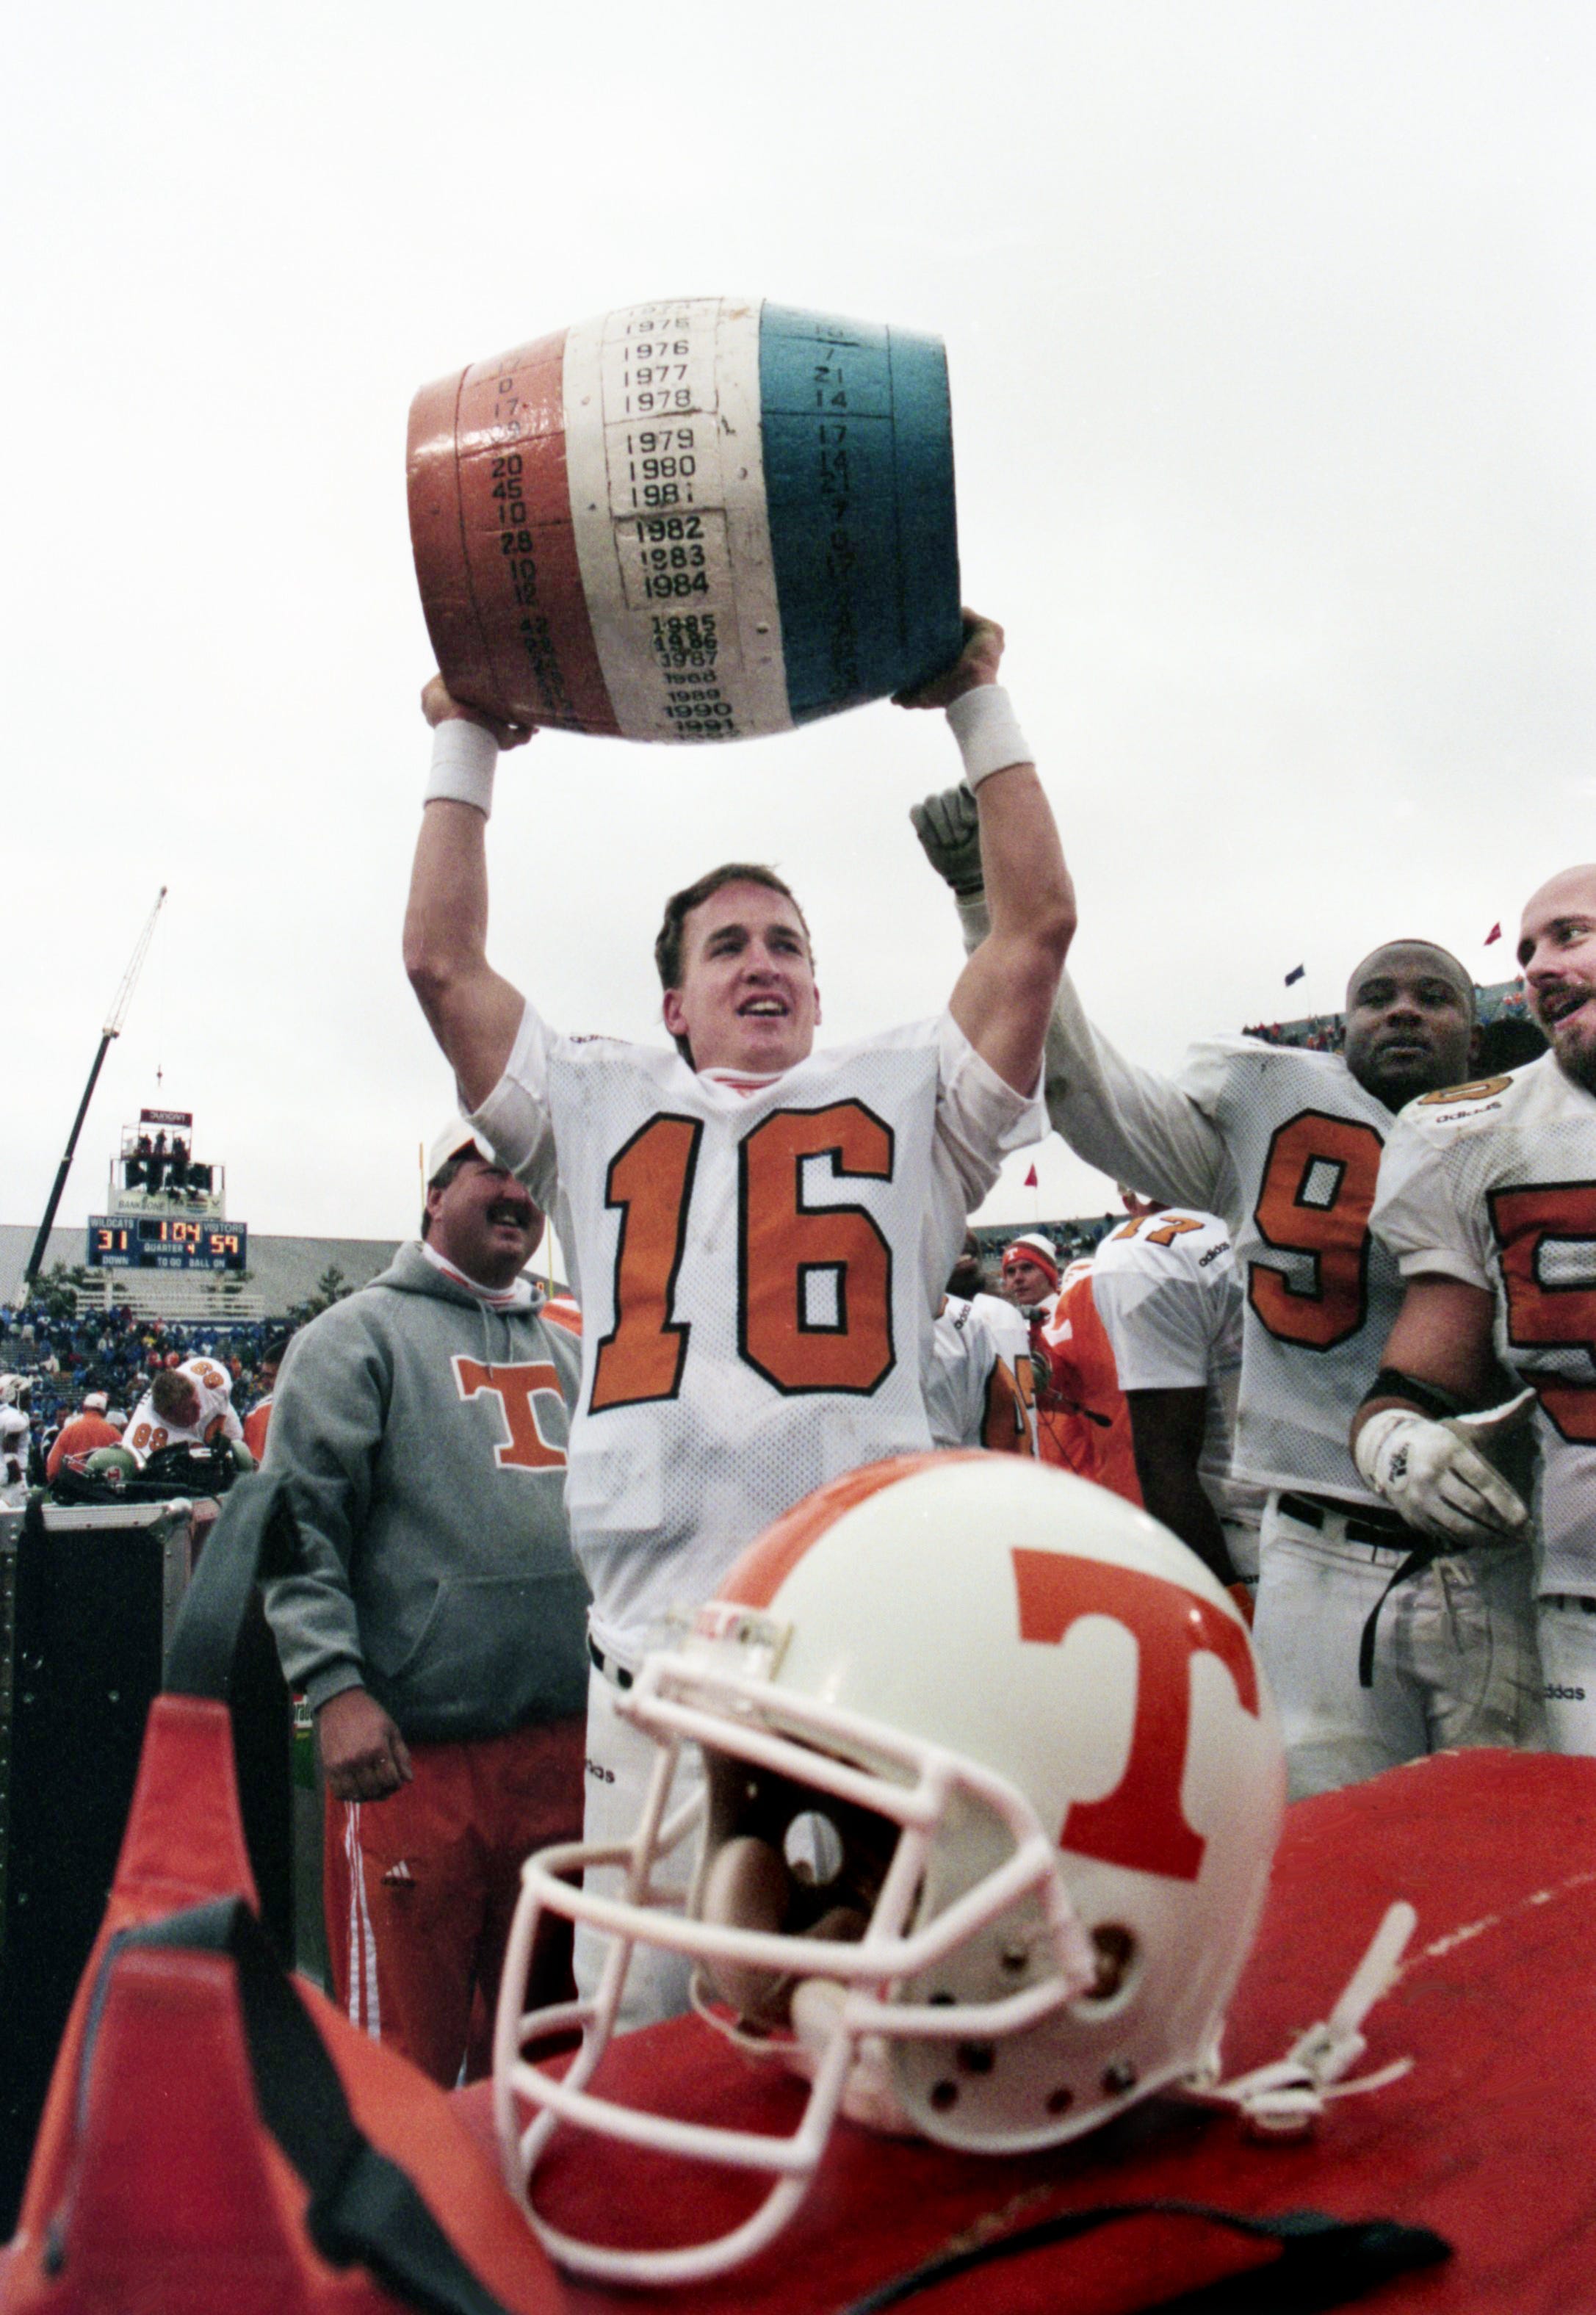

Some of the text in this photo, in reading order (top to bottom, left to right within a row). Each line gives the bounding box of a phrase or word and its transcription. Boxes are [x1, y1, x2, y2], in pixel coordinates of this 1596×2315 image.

[625, 341, 689, 361] 1976
[625, 365, 687, 387] 1977
[815, 366, 842, 383] 21
[494, 397, 519, 418] 17
[627, 389, 690, 413] 1978
[817, 390, 847, 407] 14
[628, 428, 694, 454] 1979
[819, 425, 846, 444] 17
[491, 453, 523, 478] 20
[630, 455, 696, 481] 1980
[491, 477, 522, 499] 45
[632, 483, 693, 508] 1981
[499, 501, 527, 524] 10
[636, 516, 704, 543] 1982
[500, 530, 533, 555] 28
[641, 545, 705, 571] 1983
[510, 559, 536, 582] 10
[645, 571, 709, 599] 1984
[651, 615, 716, 635] 1985
[653, 632, 718, 652] 1986
[661, 650, 718, 668] 1987
[664, 702, 732, 718] 1990
[677, 718, 734, 733] 1991
[90, 1216, 134, 1229] WILDCATS
[203, 1222, 245, 1233] VISITORS
[1111, 1216, 1206, 1248] 17
[98, 1230, 128, 1250] 31
[143, 1243, 195, 1254] QUARTER 4
[210, 1235, 238, 1255] 59
[102, 1255, 129, 1265] DOWN
[157, 1257, 182, 1268] TO GO
[189, 1257, 225, 1268] BALL ON
[588, 1098, 896, 1417] 16
[1006, 1246, 1019, 1260] T
[450, 1354, 569, 1472] T
[1011, 1547, 1260, 1884] T
